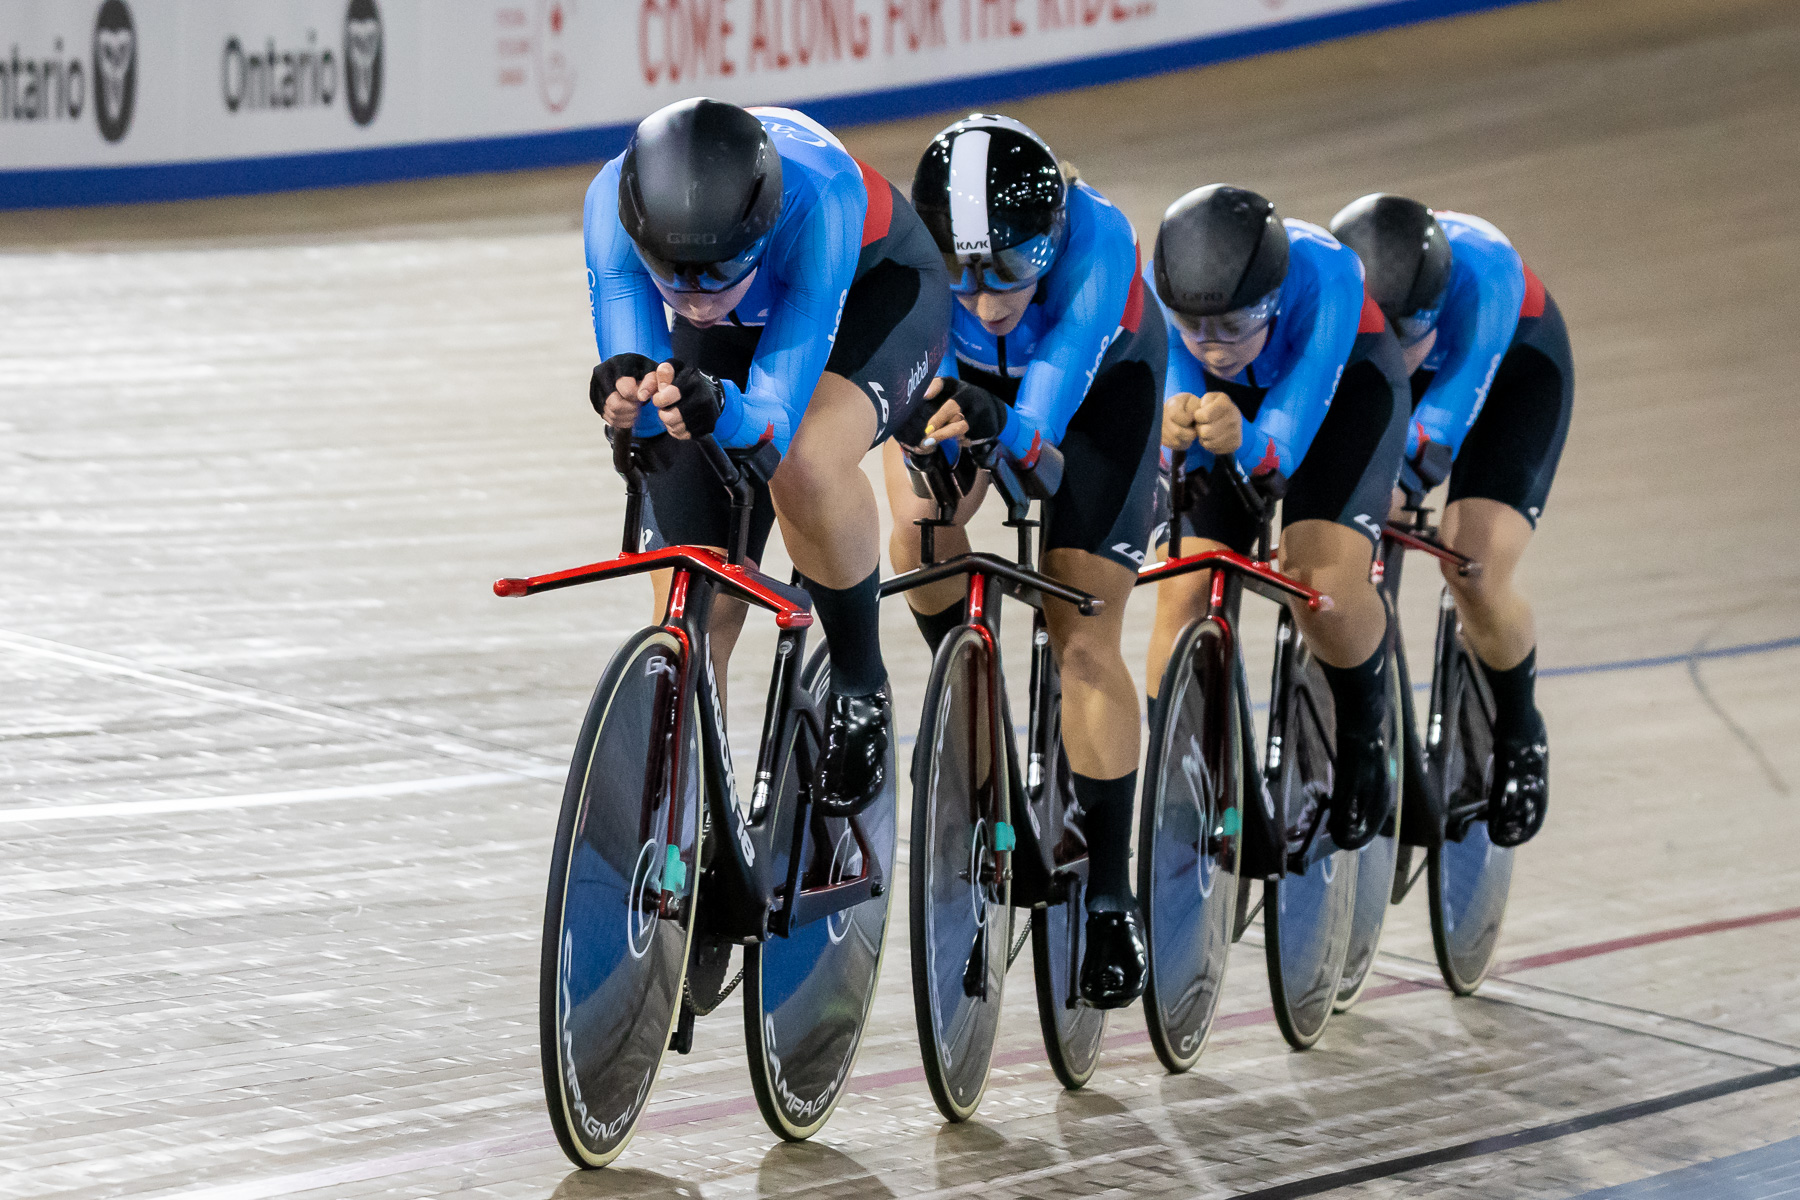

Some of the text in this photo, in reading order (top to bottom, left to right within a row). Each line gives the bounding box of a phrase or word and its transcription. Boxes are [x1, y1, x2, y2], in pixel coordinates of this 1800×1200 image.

[220, 27, 338, 114] Ontario
[637, 0, 735, 87] COME
[747, 0, 870, 73] ALONG
[666, 232, 717, 244] GIRO
[956, 240, 989, 250] KASK
[906, 350, 929, 405] global
